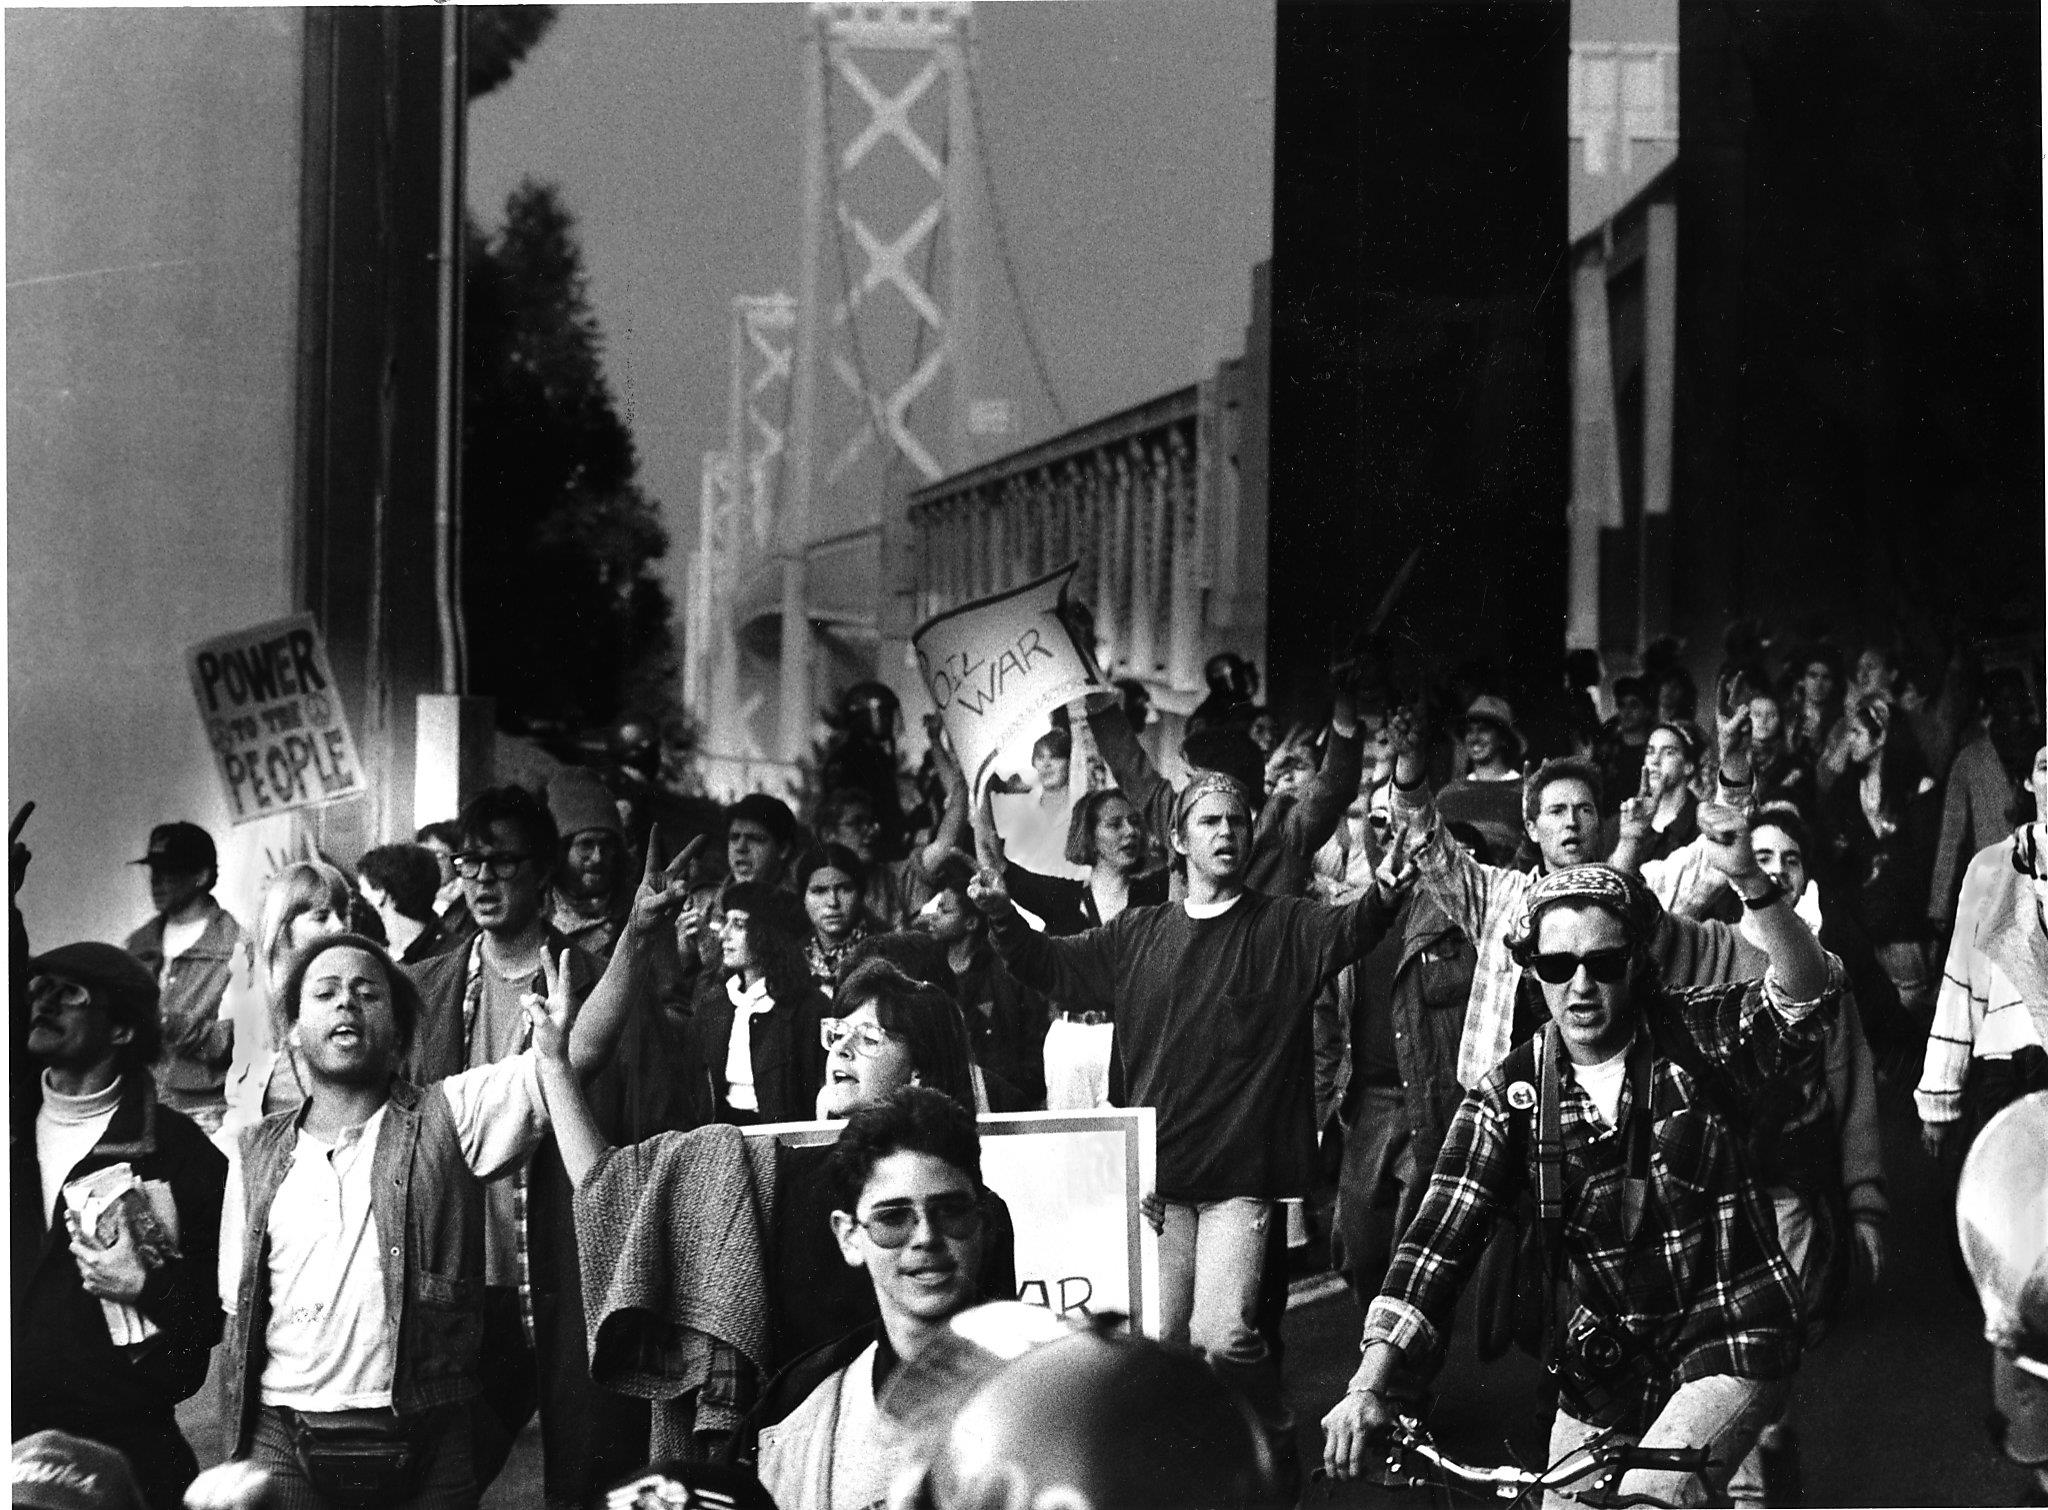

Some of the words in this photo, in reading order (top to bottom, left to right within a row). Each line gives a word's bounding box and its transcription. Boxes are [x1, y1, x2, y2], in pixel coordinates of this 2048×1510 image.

[198, 629, 327, 711] POWER
[934, 652, 985, 710] OIL
[957, 629, 1053, 715] WAR
[224, 729, 354, 814] PEOPLE
